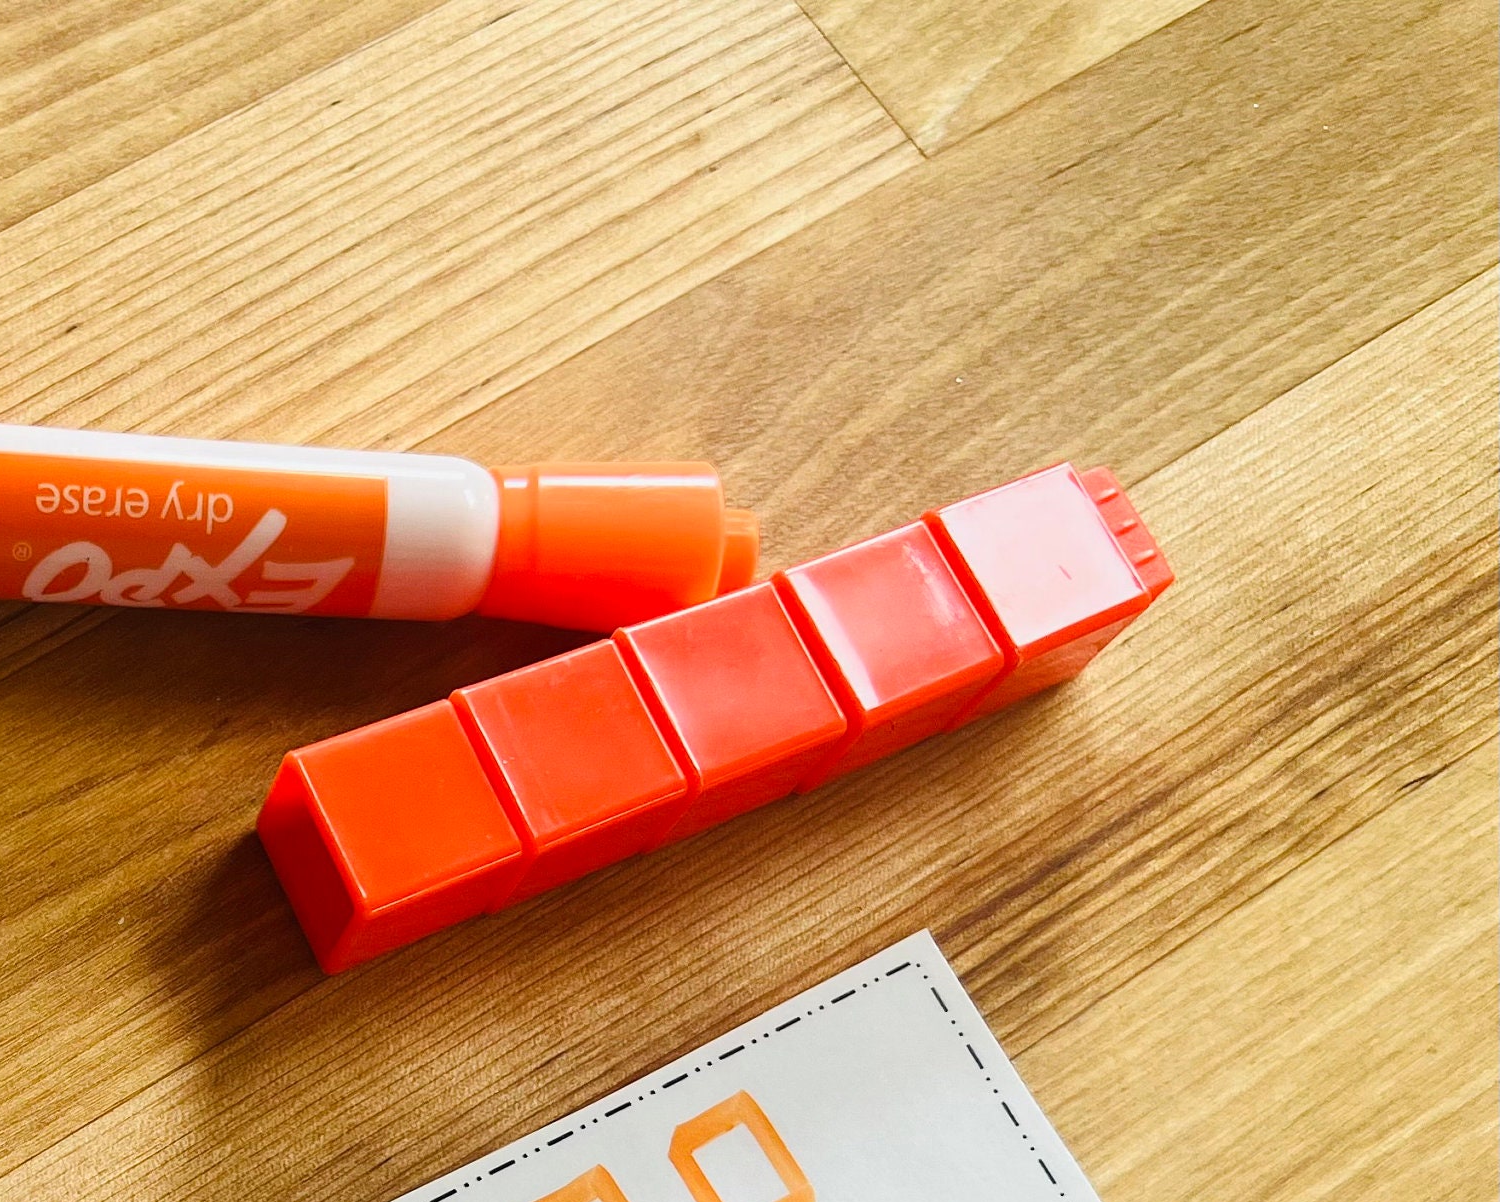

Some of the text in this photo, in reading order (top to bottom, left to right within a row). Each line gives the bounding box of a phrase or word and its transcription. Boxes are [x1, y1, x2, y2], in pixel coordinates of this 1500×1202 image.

[35, 480, 234, 535] dry erase
[21, 508, 356, 615] EXPO
